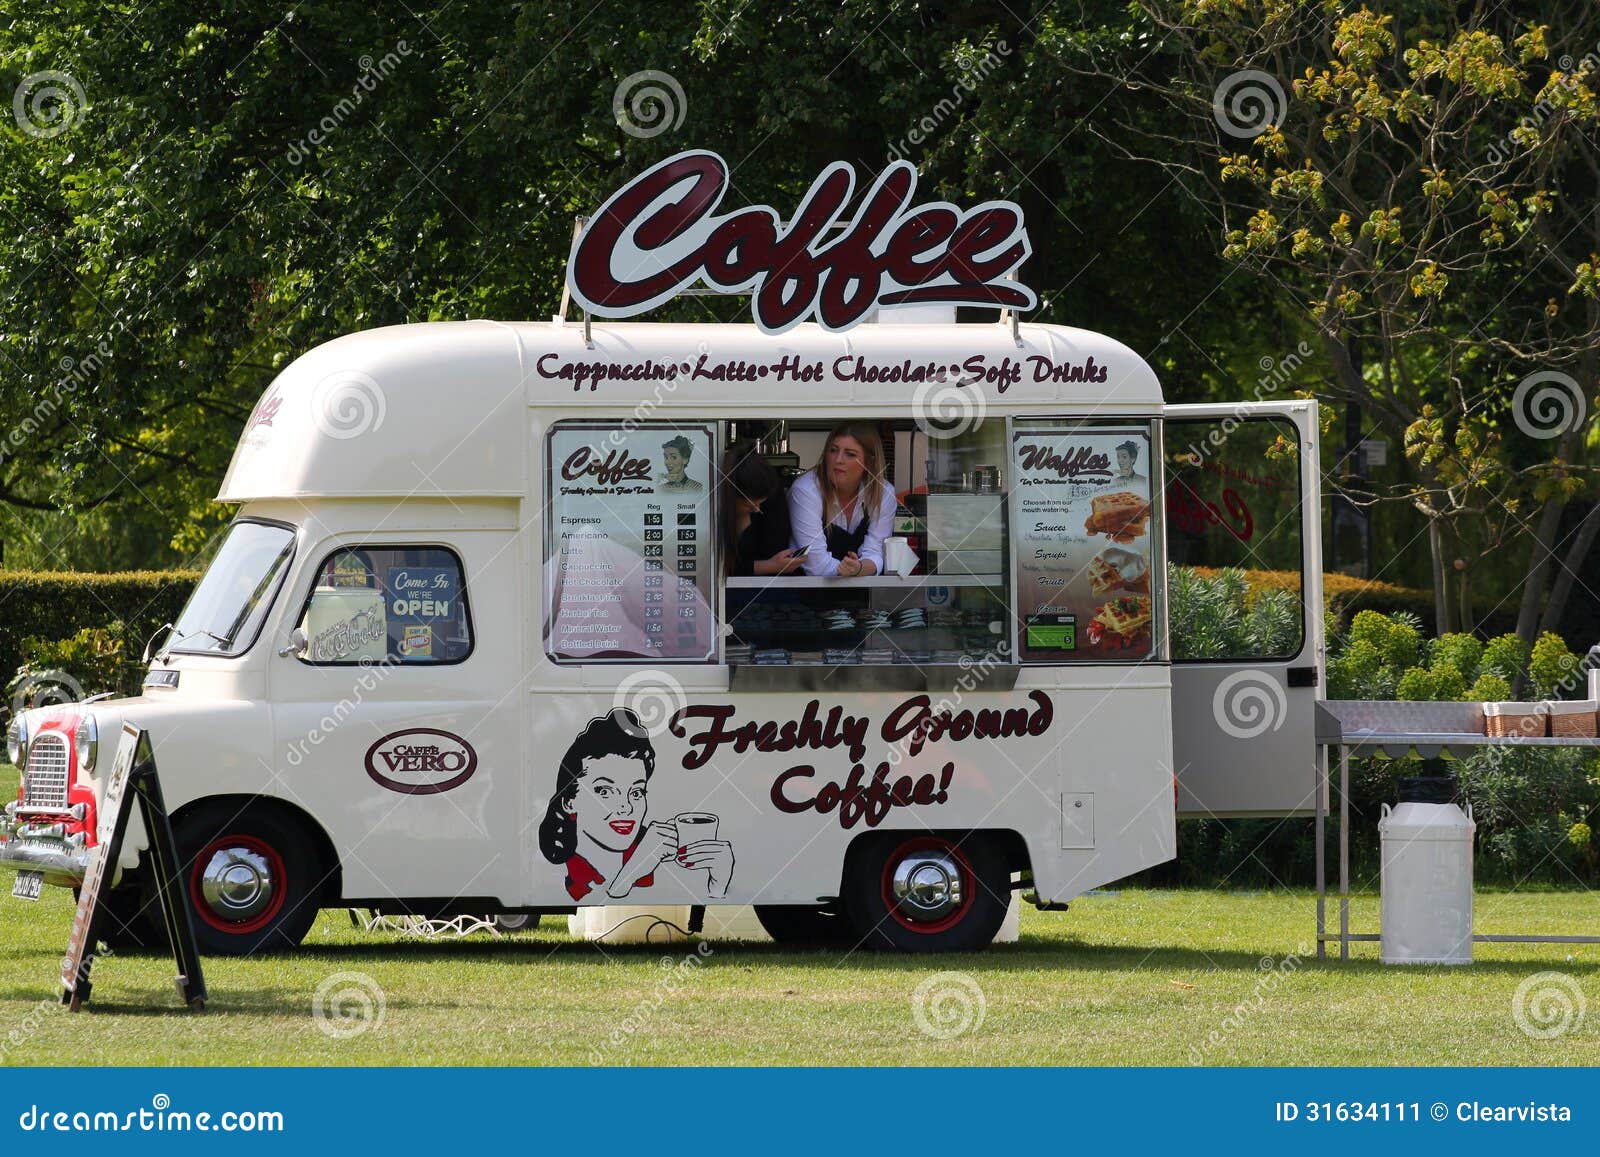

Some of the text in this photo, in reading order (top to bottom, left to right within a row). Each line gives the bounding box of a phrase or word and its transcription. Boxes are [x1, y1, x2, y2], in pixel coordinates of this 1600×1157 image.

[566, 149, 1037, 336] Coffee
[536, 353, 1108, 393] Cappuccino Latte Hot Chocolate Soft Drinks
[561, 446, 653, 485] Coffee
[1018, 445, 1114, 477] Waffles
[561, 516, 602, 525] Espresso
[1034, 522, 1066, 532] Sauces
[561, 532, 608, 540] Americano
[561, 547, 583, 555] Latte
[1034, 549, 1067, 560] Syrups
[394, 572, 450, 590] Come In
[407, 590, 433, 599] WE'RE
[392, 600, 449, 616] OPEN
[668, 689, 1054, 770] Freshly Ground
[378, 750, 466, 772] VERO
[770, 761, 955, 829] Coffee!
